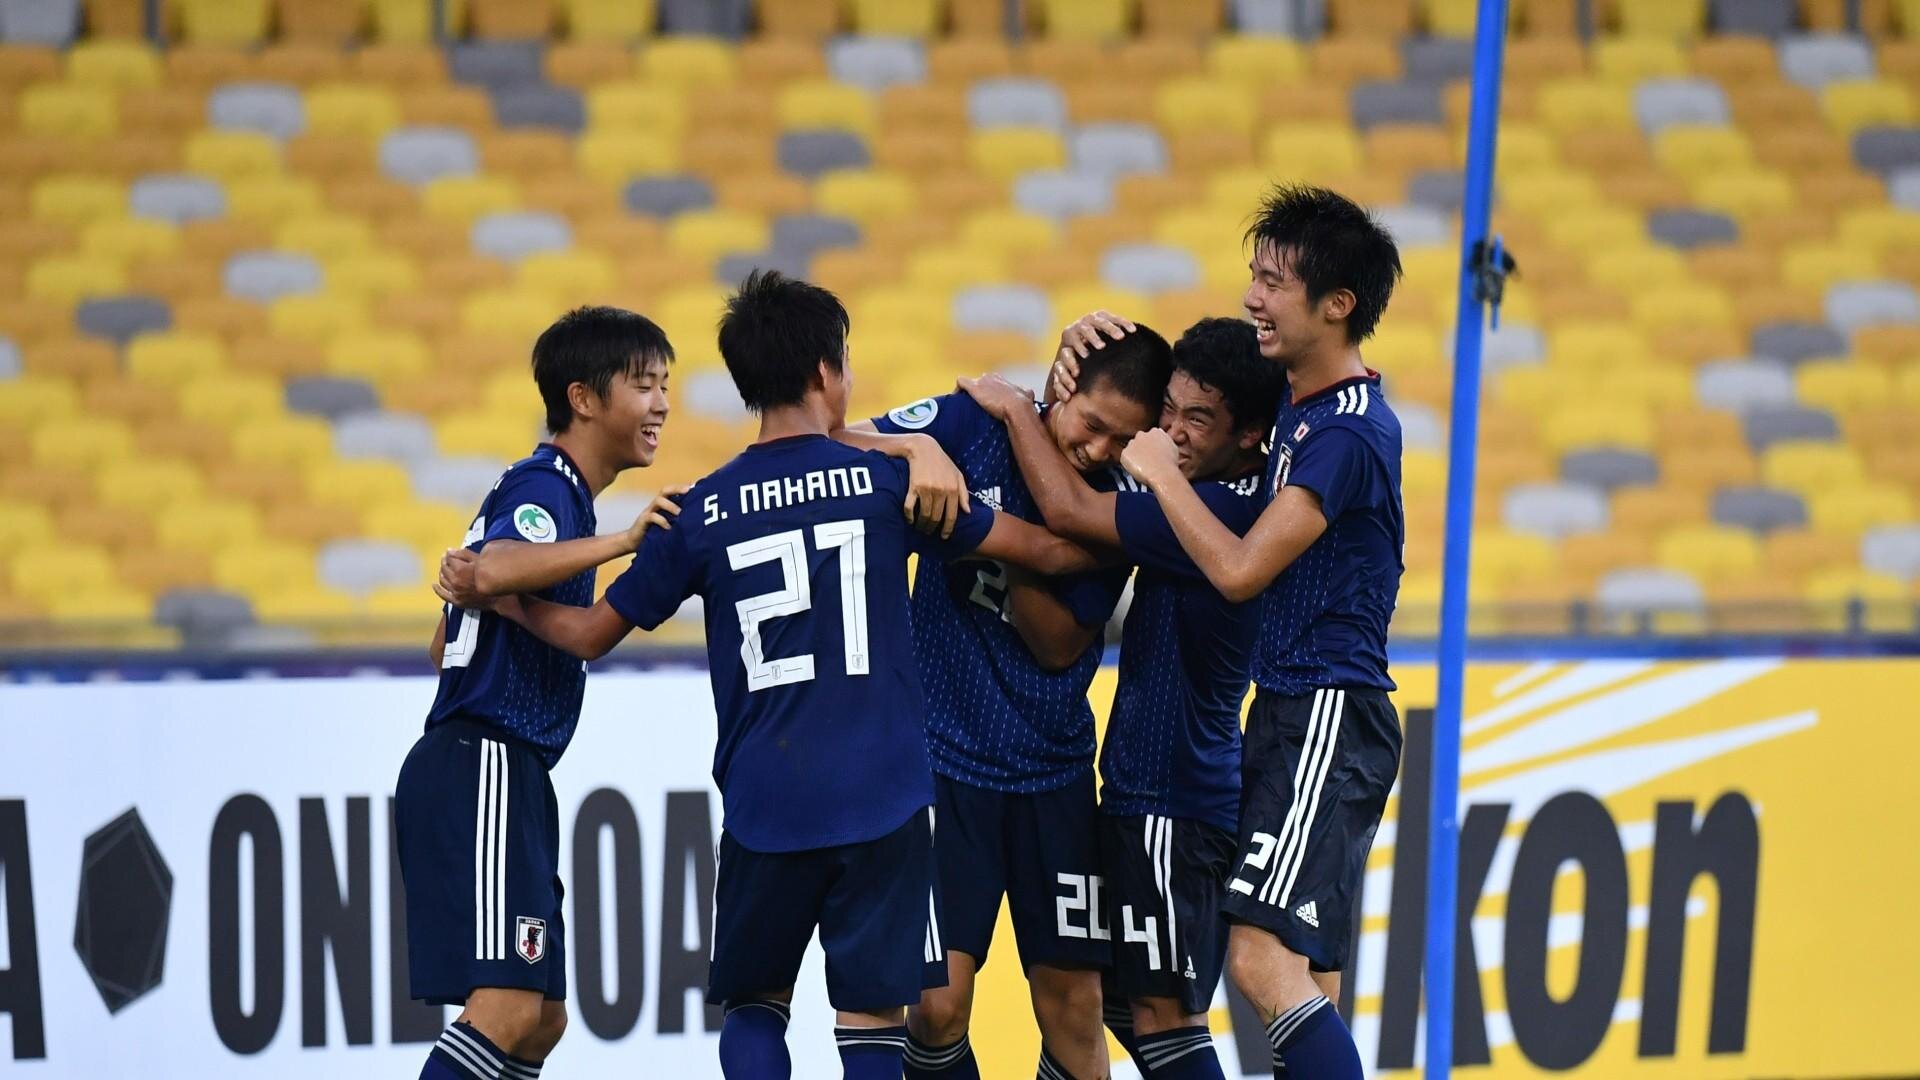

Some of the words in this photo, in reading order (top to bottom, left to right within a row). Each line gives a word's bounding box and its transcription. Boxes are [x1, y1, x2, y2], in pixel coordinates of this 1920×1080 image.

[703, 493, 728, 526] S.
[740, 466, 873, 514] NAKANO
[726, 519, 870, 693] 21
[1056, 872, 1111, 941] 20
[1222, 707, 1760, 1074] kon
[1122, 905, 1161, 970] 4
